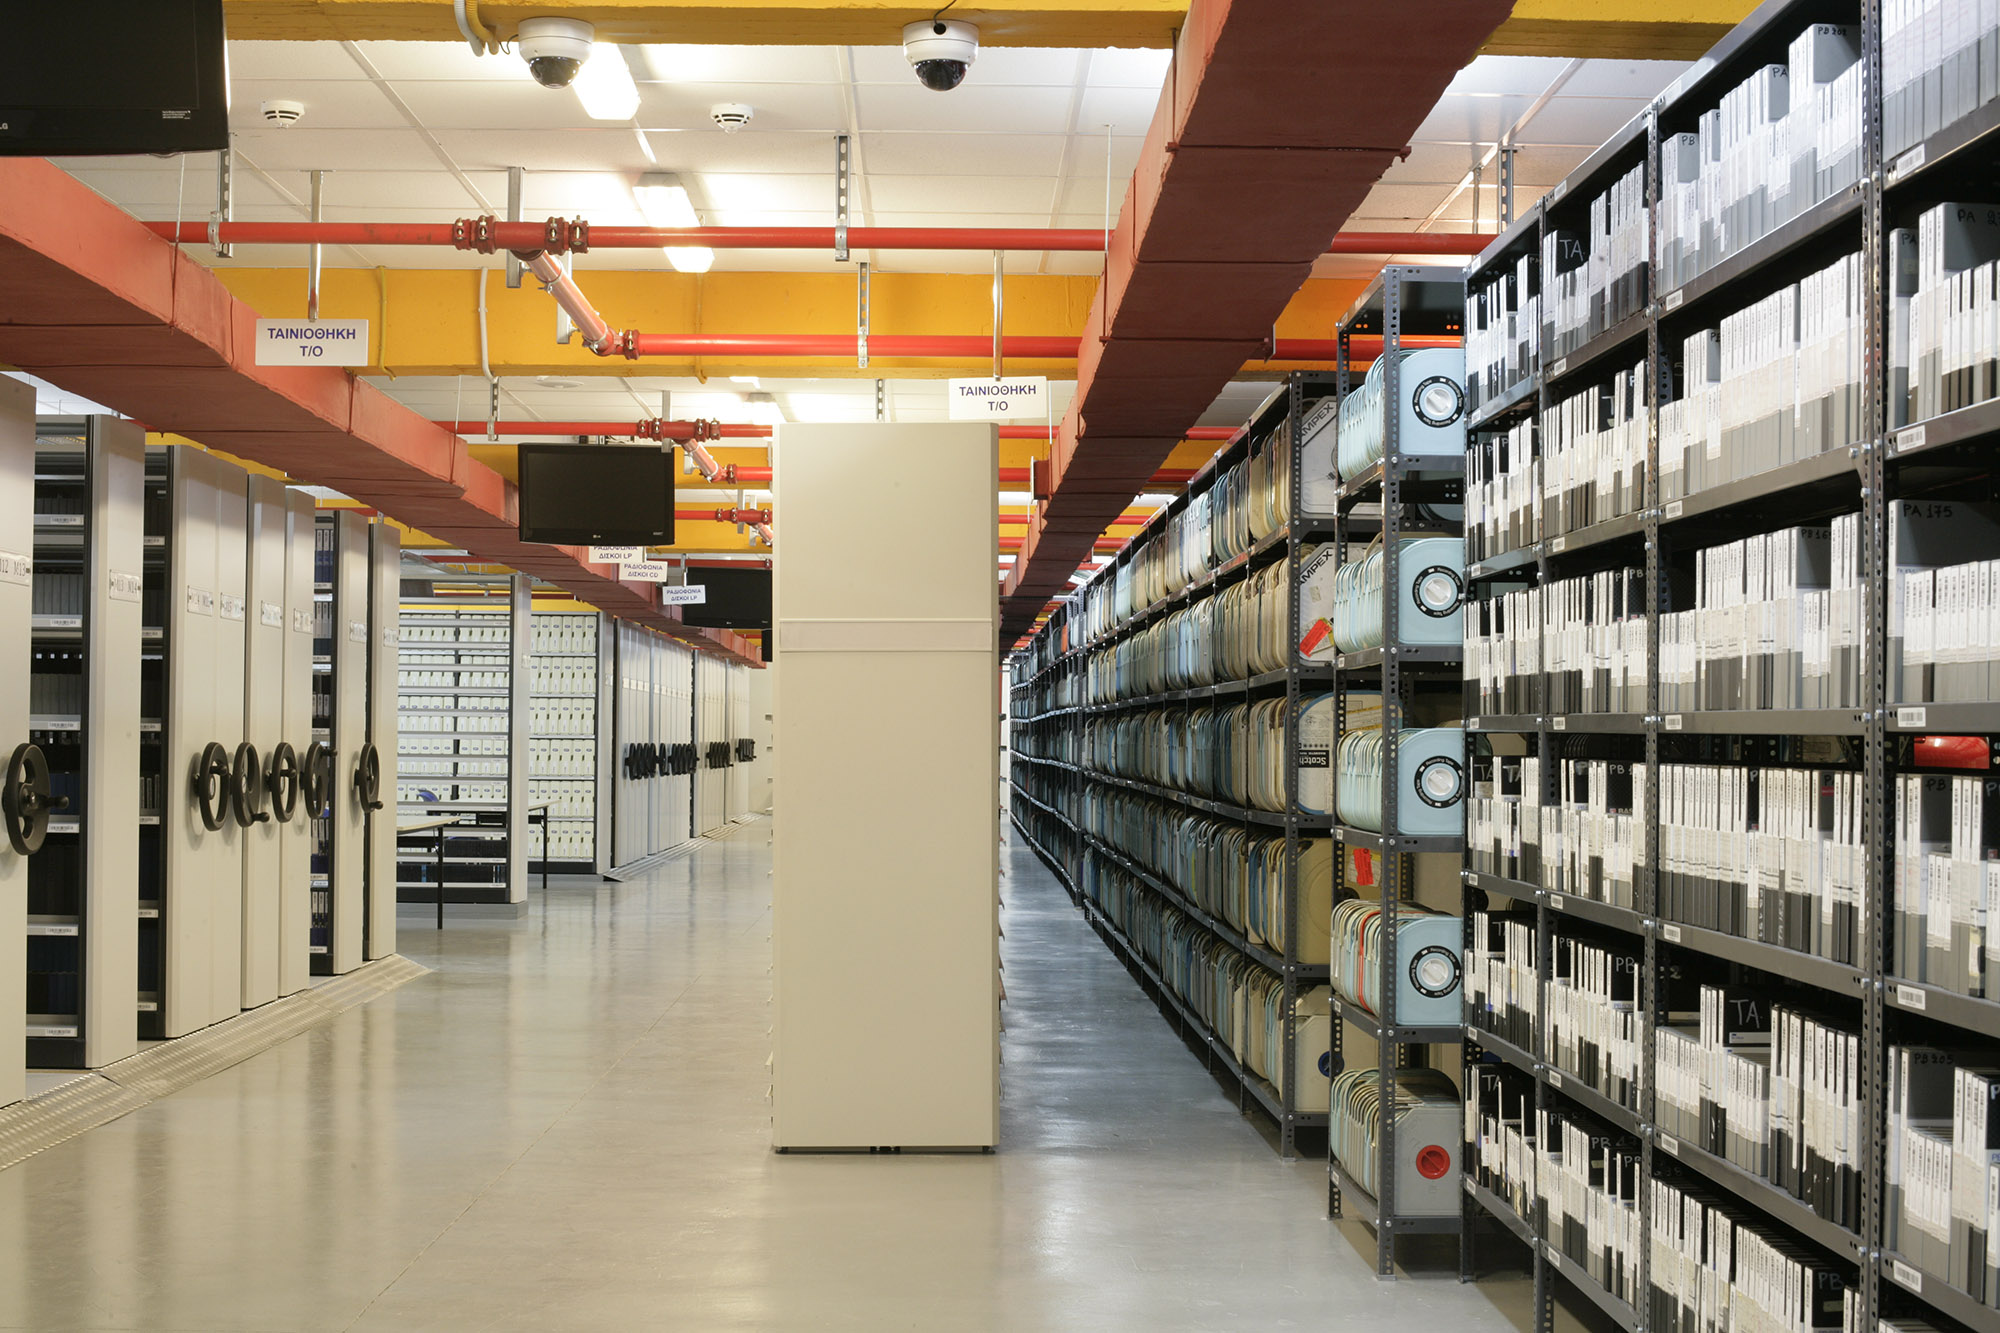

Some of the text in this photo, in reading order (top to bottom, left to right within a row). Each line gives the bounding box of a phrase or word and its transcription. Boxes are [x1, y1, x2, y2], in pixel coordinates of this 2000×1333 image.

[1681, 135, 1696, 146] PB
[267, 328, 356, 340] ΤΑΙΝΙΟΘΗΚΗ
[300, 345, 324, 357] Τ/Ο
[959, 384, 1037, 396] ΤΑΙΝΙΟΘΗΚΗ
[988, 401, 1009, 411] Τ/Ο
[1903, 504, 1953, 518] PA 175
[1609, 764, 1625, 775] PB
[1615, 956, 1635, 974] PB
[1818, 1271, 1845, 1291] PB
